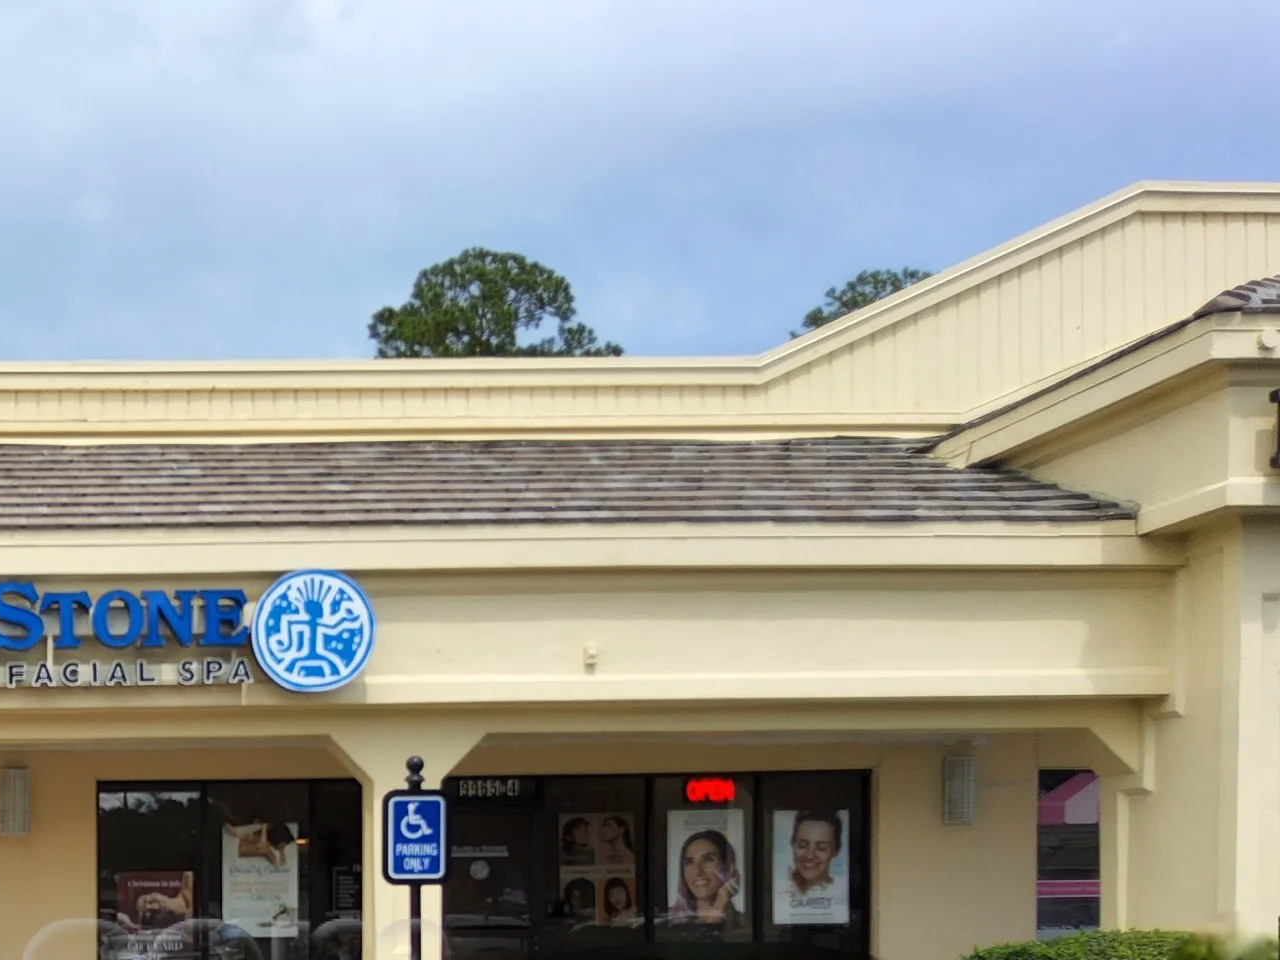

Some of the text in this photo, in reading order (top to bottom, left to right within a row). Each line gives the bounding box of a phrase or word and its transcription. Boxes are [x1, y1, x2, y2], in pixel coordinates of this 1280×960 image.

[6, 661, 156, 688] FACIAL
[177, 657, 255, 685] SPA
[686, 778, 735, 802] OPEN
[395, 843, 438, 857] PARKING
[403, 857, 431, 871] ONLY
